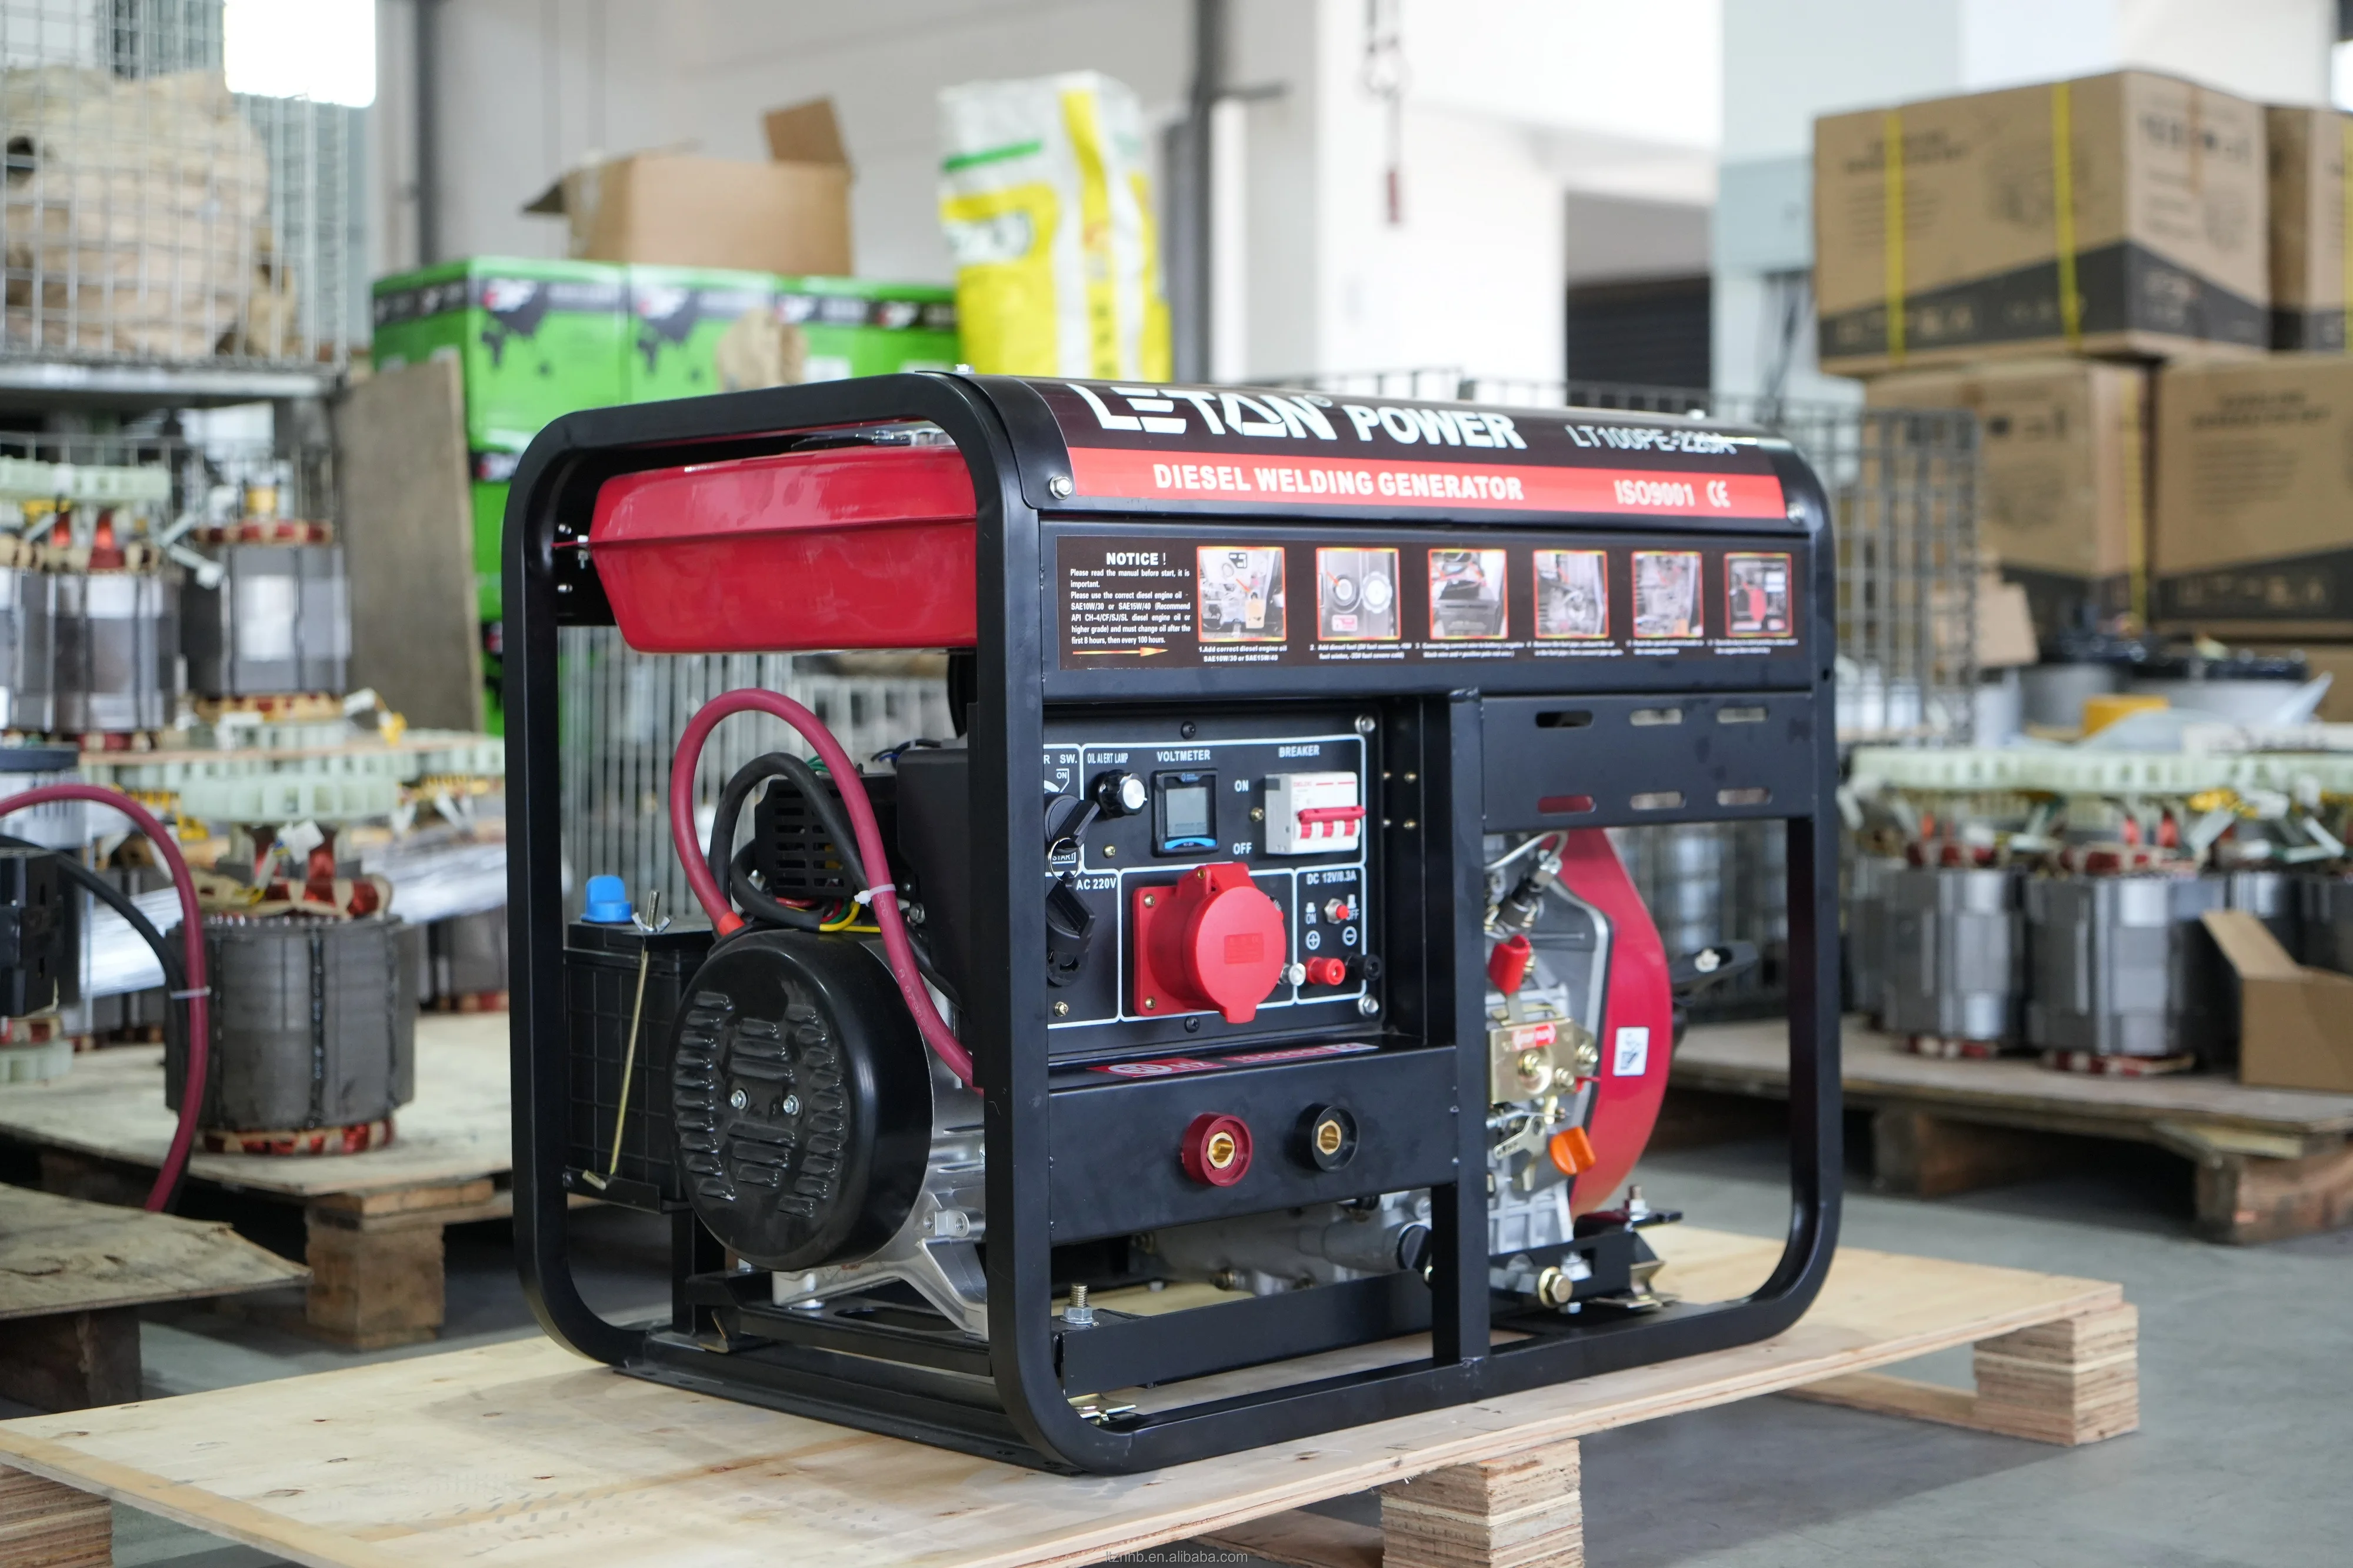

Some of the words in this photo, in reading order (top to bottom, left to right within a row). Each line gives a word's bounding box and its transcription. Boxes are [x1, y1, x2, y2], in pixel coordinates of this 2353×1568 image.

[1342, 404, 1528, 449] POWER
[1153, 464, 1251, 491] DIESEL
[1254, 468, 1374, 495] WELDING
[1378, 472, 1524, 500] GENERATOR
[1614, 480, 1695, 507] ISO9001
[1106, 552, 1158, 565] NOTICE
[1071, 580, 1100, 589] important.
[1155, 592, 1172, 600] engine
[1071, 602, 1104, 610] SAE10W/30
[1118, 602, 1151, 610] SAE15W/40
[1155, 602, 1191, 610] (Recommend
[1152, 614, 1170, 622] engine
[1071, 625, 1089, 634] higher
[1091, 625, 1108, 634] grade)
[1138, 625, 1158, 633] change
[1089, 636, 1106, 645] hours,
[1157, 750, 1210, 762] VOLTMETER
[1278, 745, 1320, 758] BREAKER
[1060, 754, 1077, 764] SW.
[1087, 753, 1096, 764] OIL
[1115, 753, 1128, 763] LAMP
[1234, 780, 1249, 792] ON
[1233, 842, 1252, 855] OFF
[1076, 879, 1091, 890] AC
[1093, 878, 1116, 890] 220V
[1307, 873, 1319, 885] DC
[1305, 912, 1317, 925] ON
